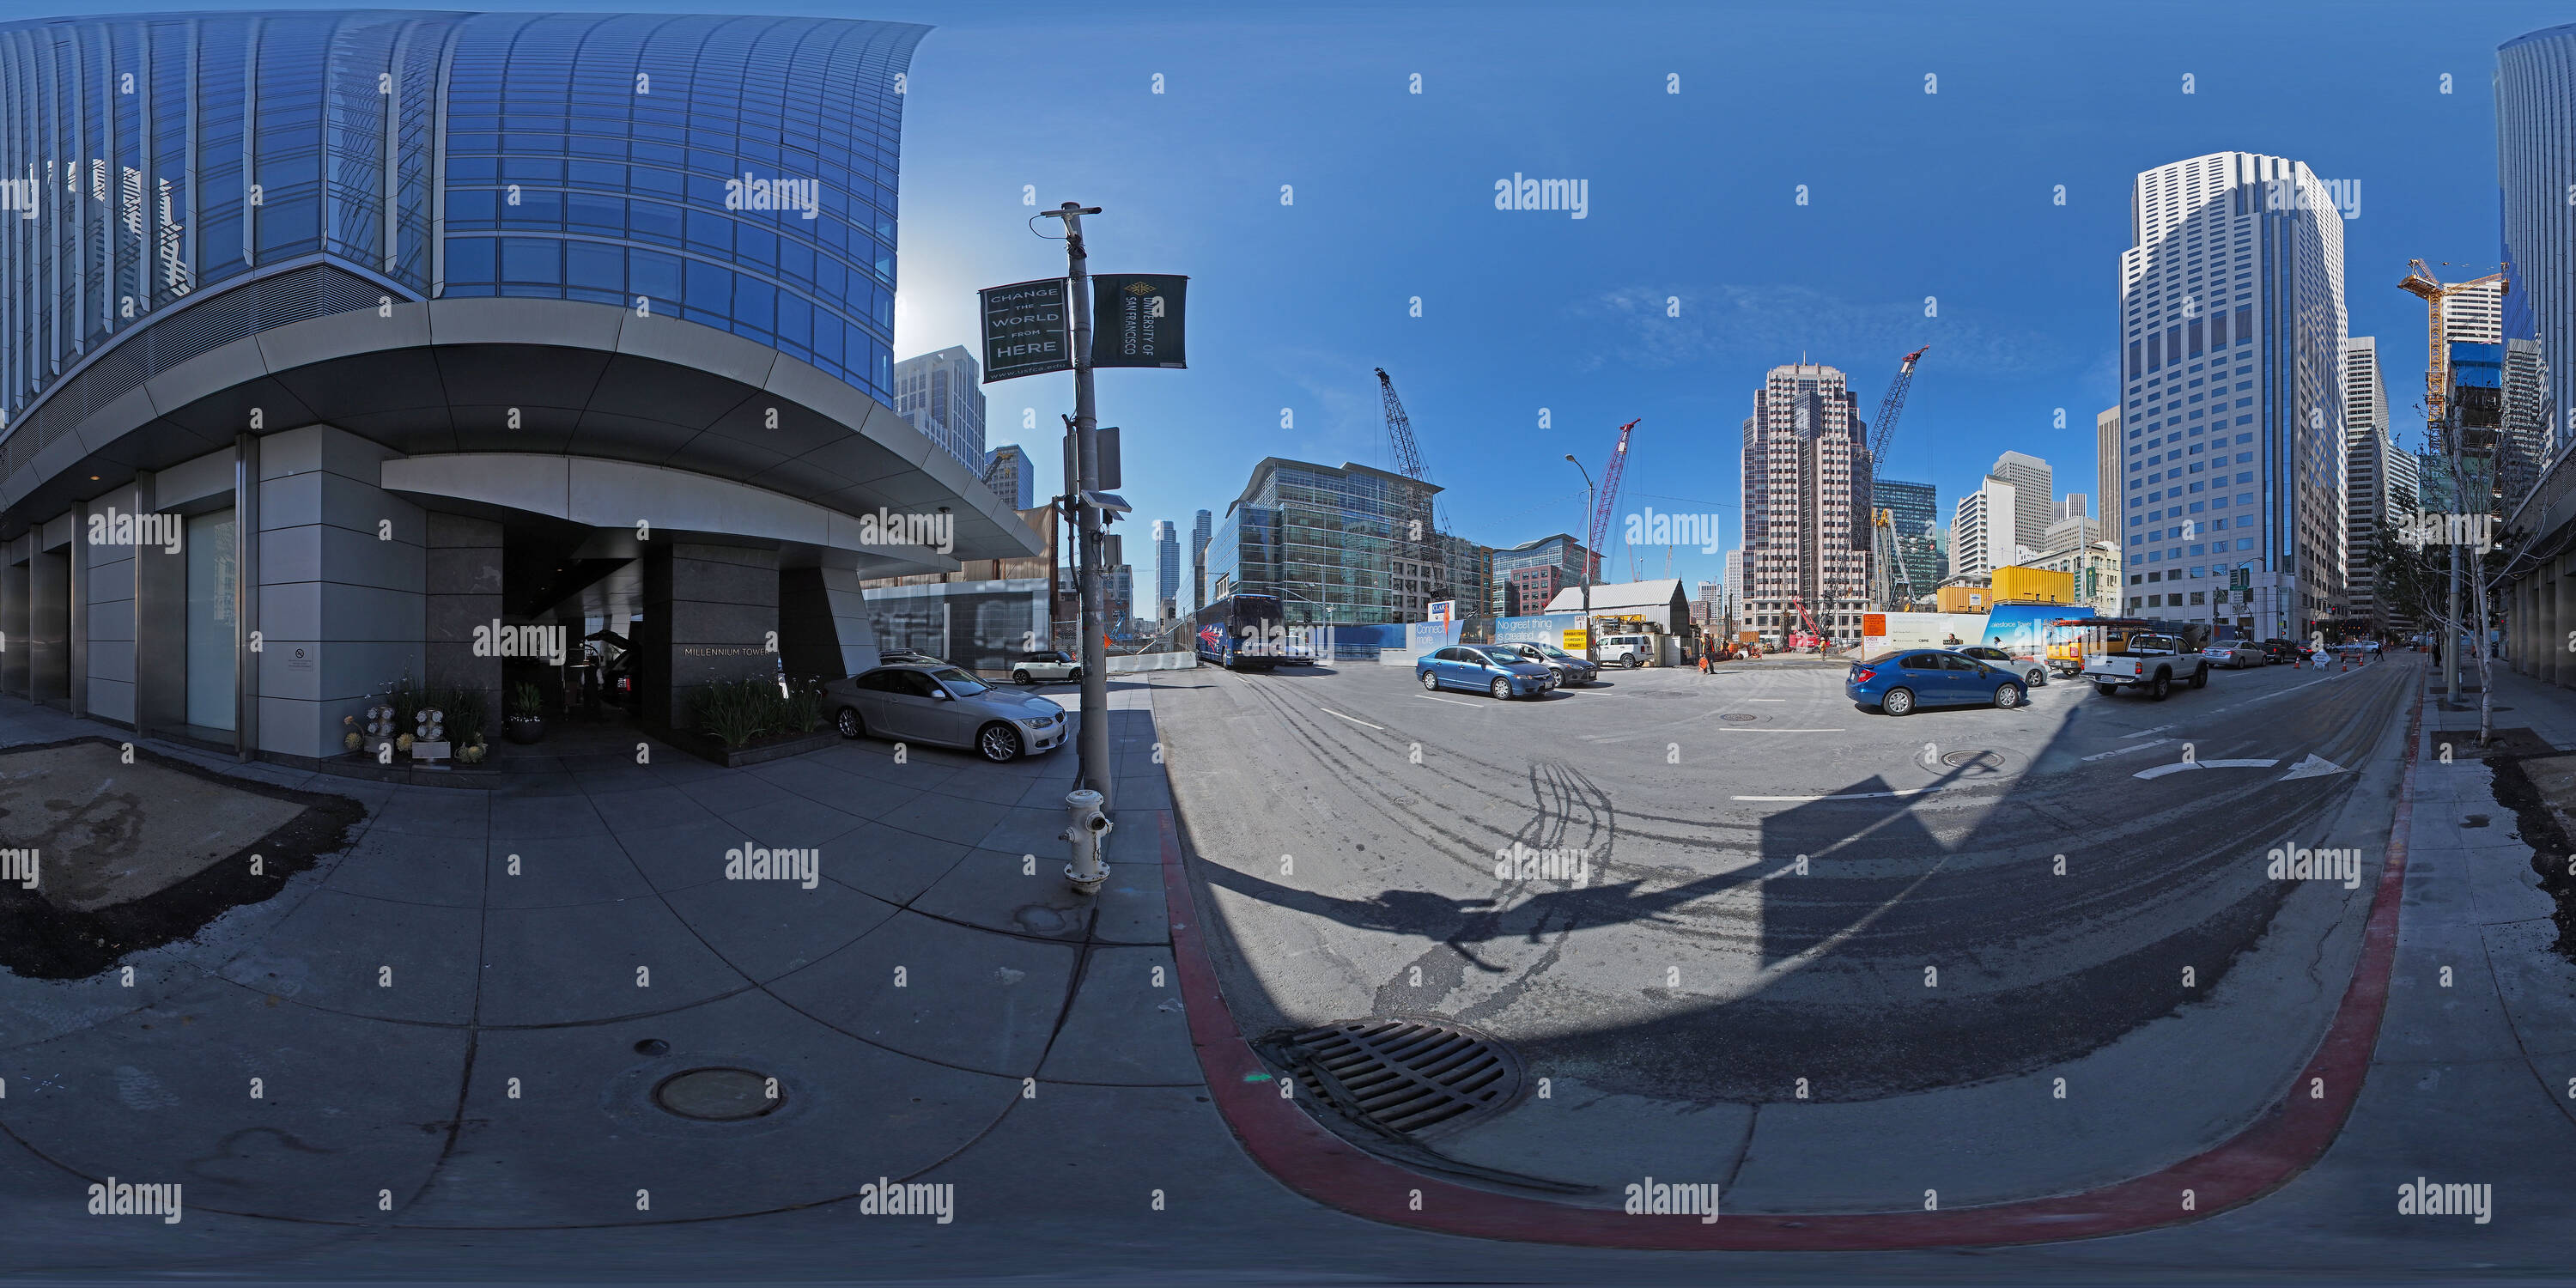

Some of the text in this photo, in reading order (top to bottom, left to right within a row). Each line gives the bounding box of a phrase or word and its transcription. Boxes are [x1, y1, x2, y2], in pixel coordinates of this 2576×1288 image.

[991, 289, 1059, 303] CHANGE
[993, 314, 1059, 327] WORLD
[1125, 297, 1137, 355] SAN FRANCISCO
[1143, 297, 1154, 356] UNIVERSITY OF
[1012, 330, 1040, 338] FROM
[998, 342, 1057, 358] HERE
[990, 363, 1066, 379] www.usfca.edu
[1417, 623, 1446, 634] Connect
[1498, 617, 1552, 631] No great thing
[1497, 630, 1534, 641] is created
